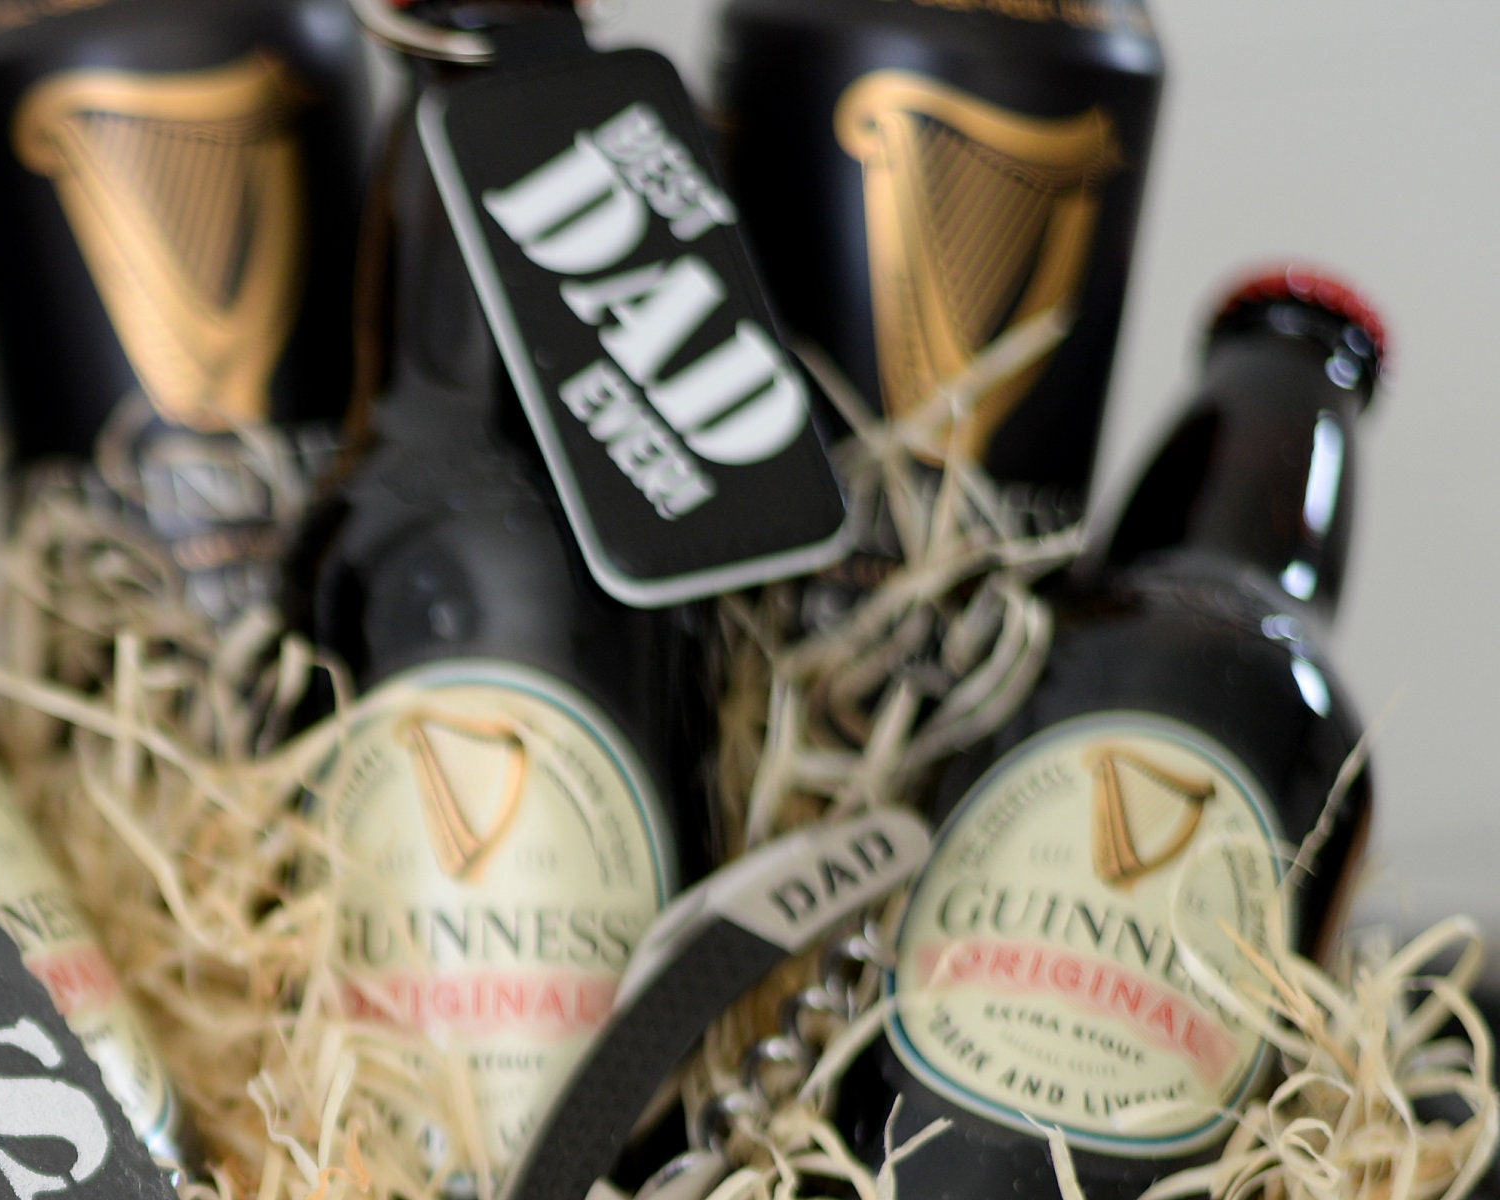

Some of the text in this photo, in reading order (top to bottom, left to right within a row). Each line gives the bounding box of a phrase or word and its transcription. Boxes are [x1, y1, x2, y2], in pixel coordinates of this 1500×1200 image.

[592, 102, 738, 243] BEST
[483, 131, 809, 466] DAD
[558, 360, 717, 520] EVER!
[770, 829, 894, 924] DAD
[340, 906, 632, 970] UINNESS
[996, 1063, 1067, 1106] AND
